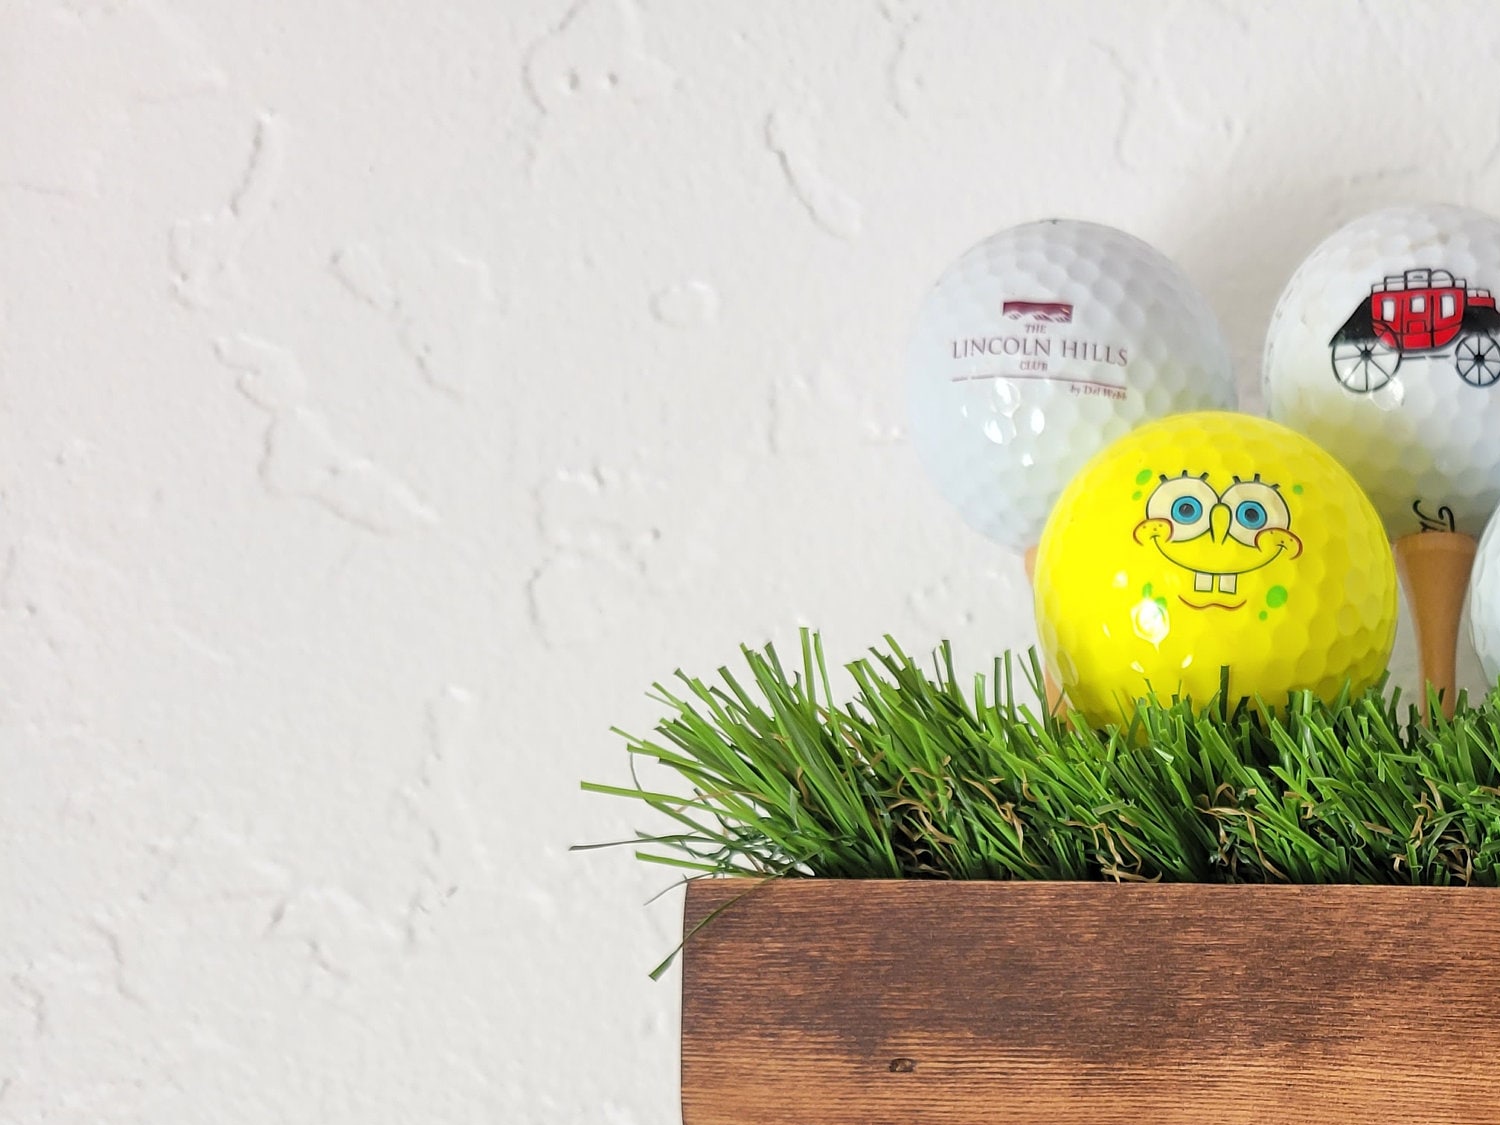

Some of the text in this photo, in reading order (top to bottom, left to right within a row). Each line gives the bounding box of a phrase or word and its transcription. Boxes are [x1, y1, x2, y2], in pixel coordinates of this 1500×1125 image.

[1024, 323, 1047, 334] THE
[951, 336, 1128, 367] LINCOLN HILLS
[1019, 360, 1048, 372] CLUB
[1070, 384, 1081, 397] by
